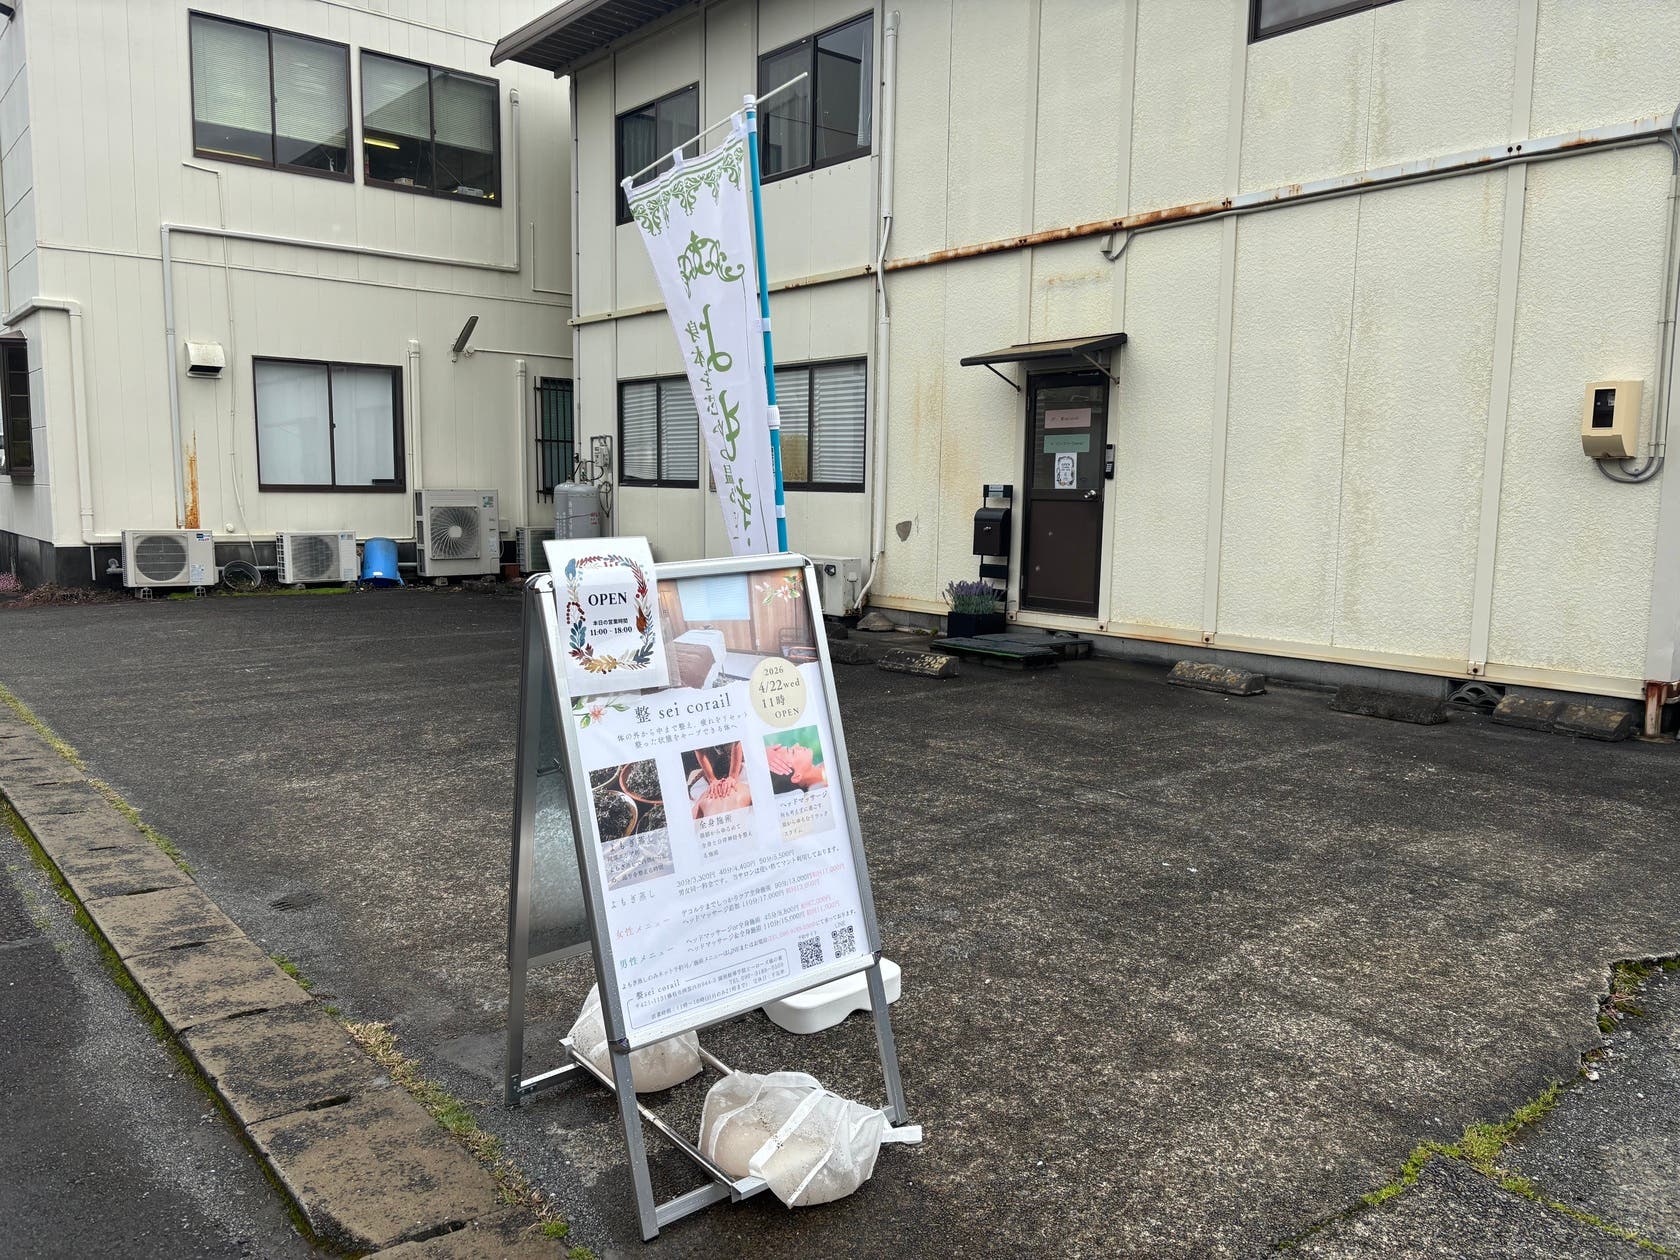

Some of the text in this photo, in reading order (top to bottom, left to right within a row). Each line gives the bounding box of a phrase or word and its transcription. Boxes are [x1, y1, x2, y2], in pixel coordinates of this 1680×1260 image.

[588, 593, 627, 606] OPEN
[593, 618, 628, 626] 本日の営業時間
[590, 628, 608, 636] 11:00
[764, 667, 784, 676] 2026
[635, 693, 730, 724] 整 sei corail
[762, 696, 785, 709] 11時
[775, 708, 799, 719] OPEN
[611, 890, 656, 909] よもぎ蒸し
[614, 916, 670, 940] 女性メニュー
[618, 945, 674, 970] 男性メニュー
